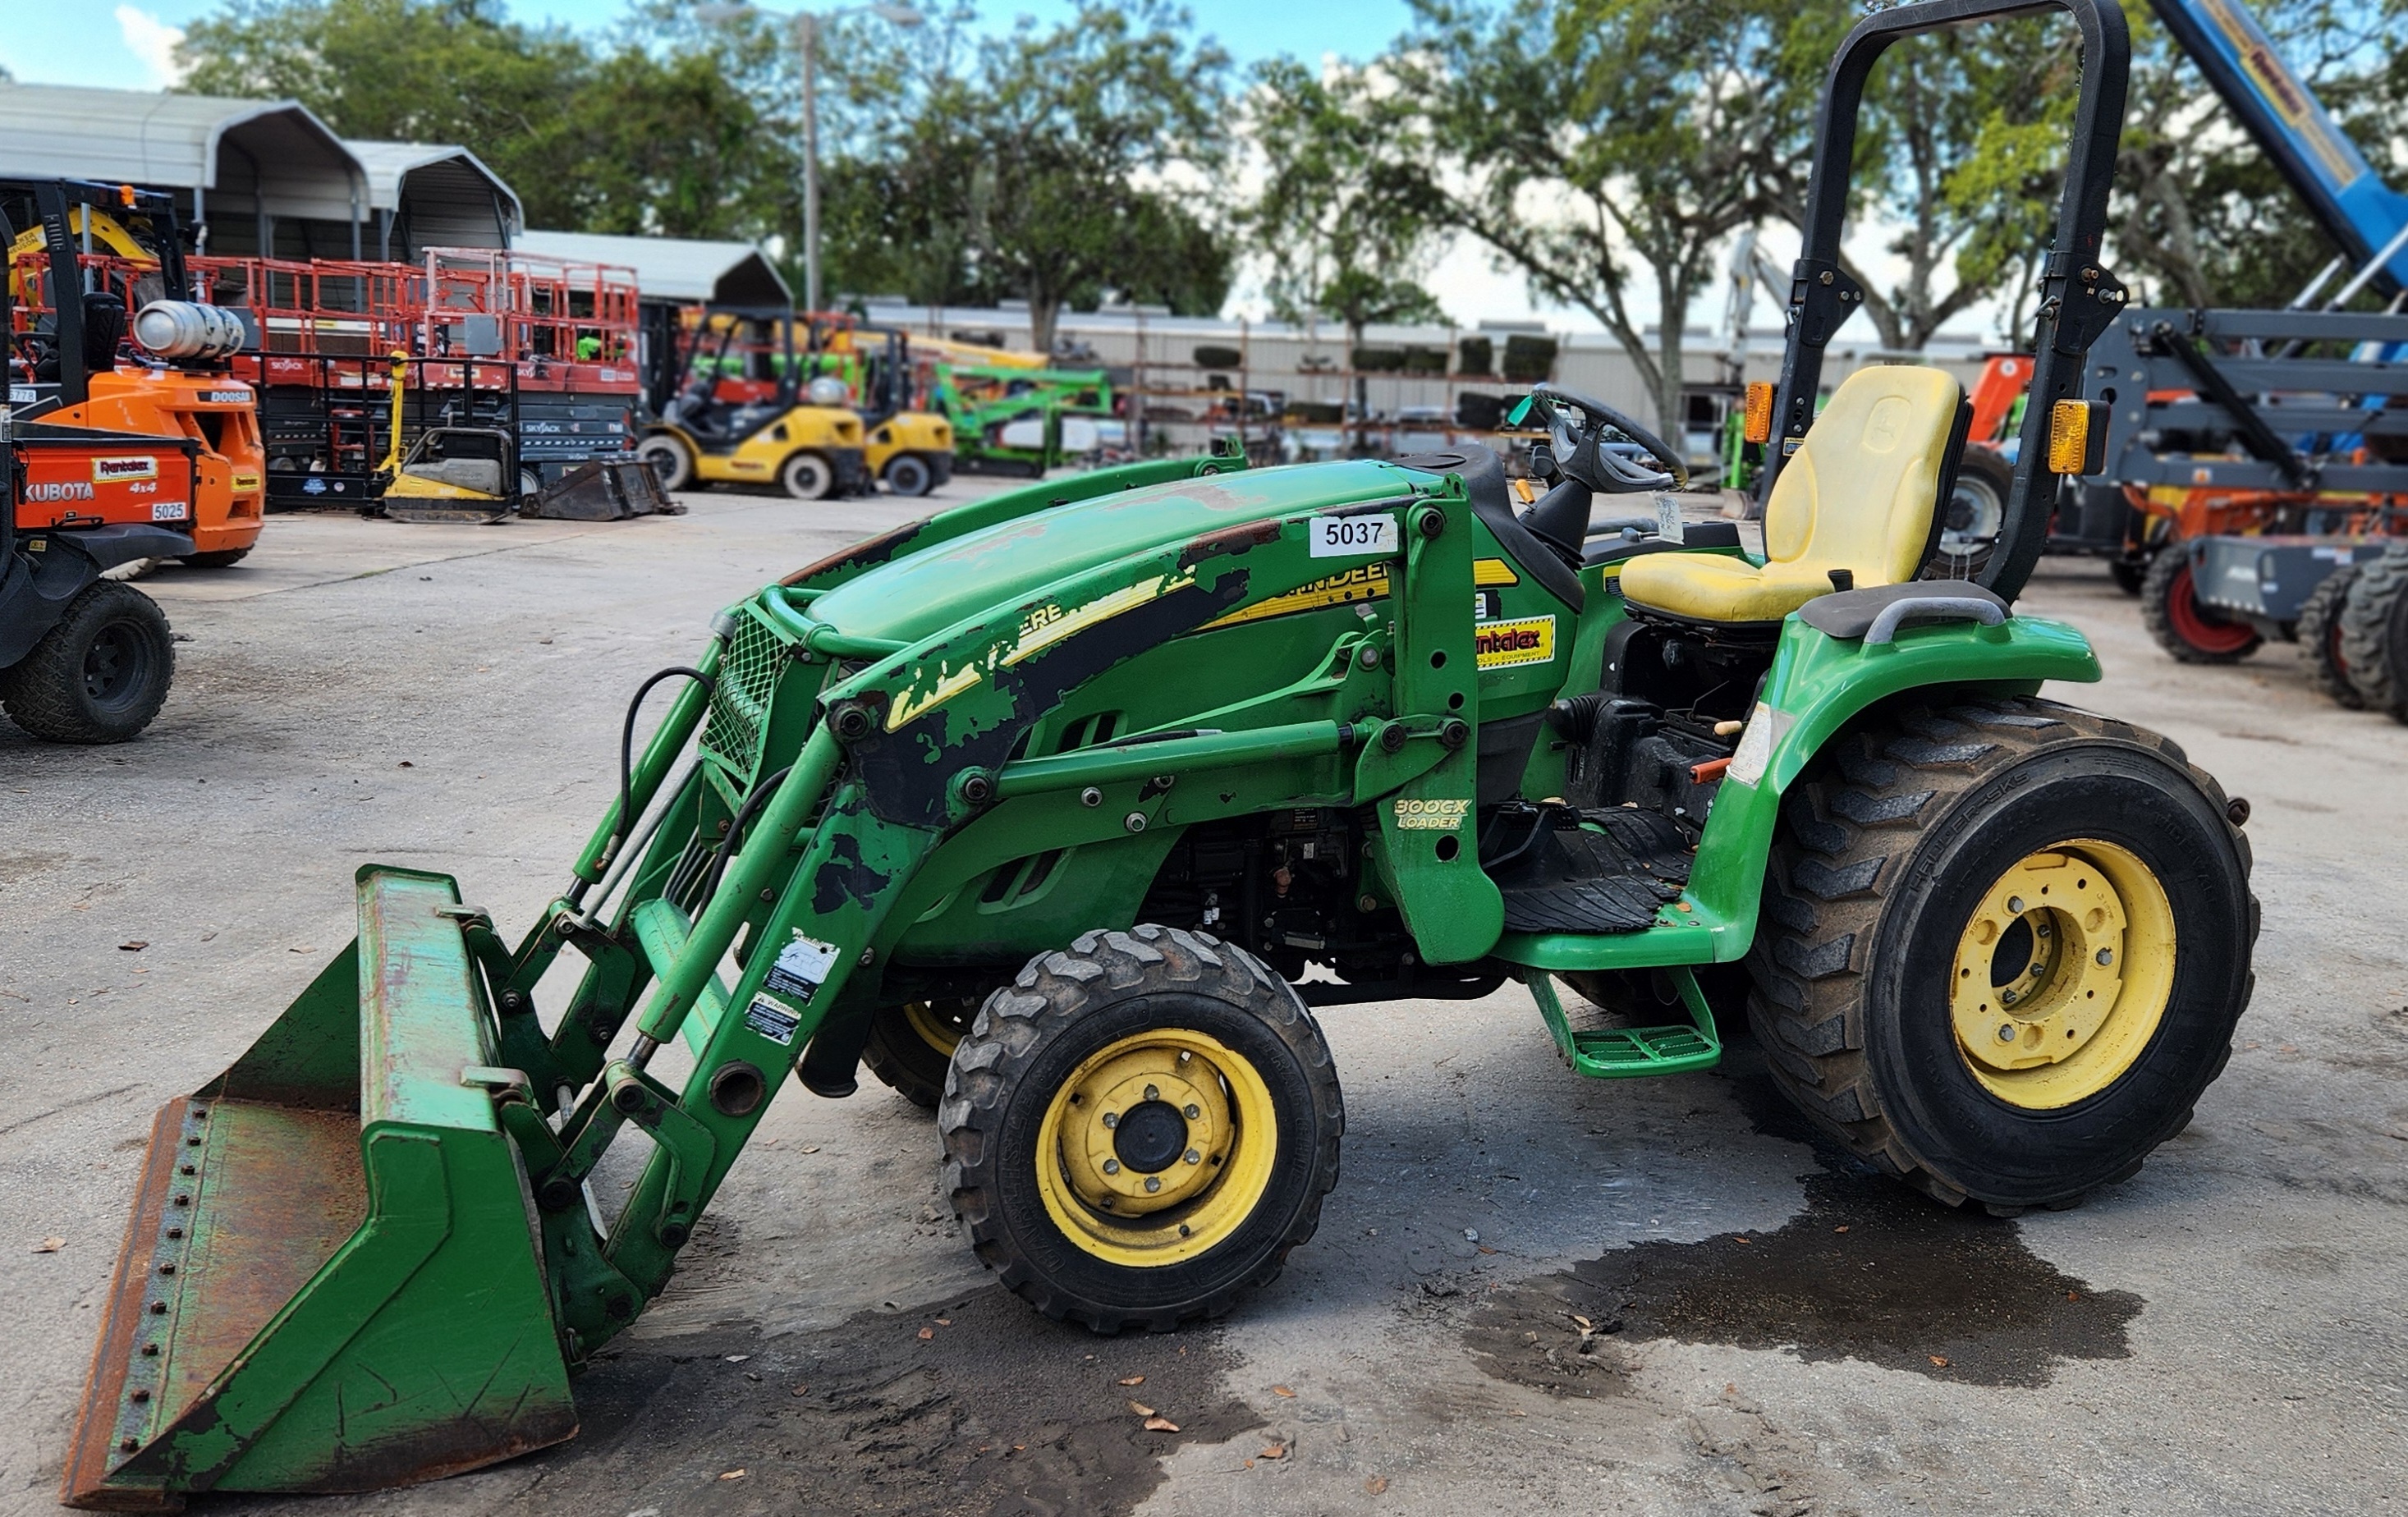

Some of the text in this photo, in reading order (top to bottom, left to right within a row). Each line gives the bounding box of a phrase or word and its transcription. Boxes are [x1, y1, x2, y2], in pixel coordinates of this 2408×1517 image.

[271, 359, 304, 372] SKYJACK
[525, 421, 561, 433] SKYJACK
[25, 482, 95, 502] KUBOTA
[129, 482, 157, 493] 4x4
[154, 504, 184, 520] 5025
[1326, 522, 1384, 545] 5037
[1502, 651, 1540, 661] EQUIPMENT
[1394, 799, 1472, 815] 300CX
[1397, 816, 1461, 829] LOADER
